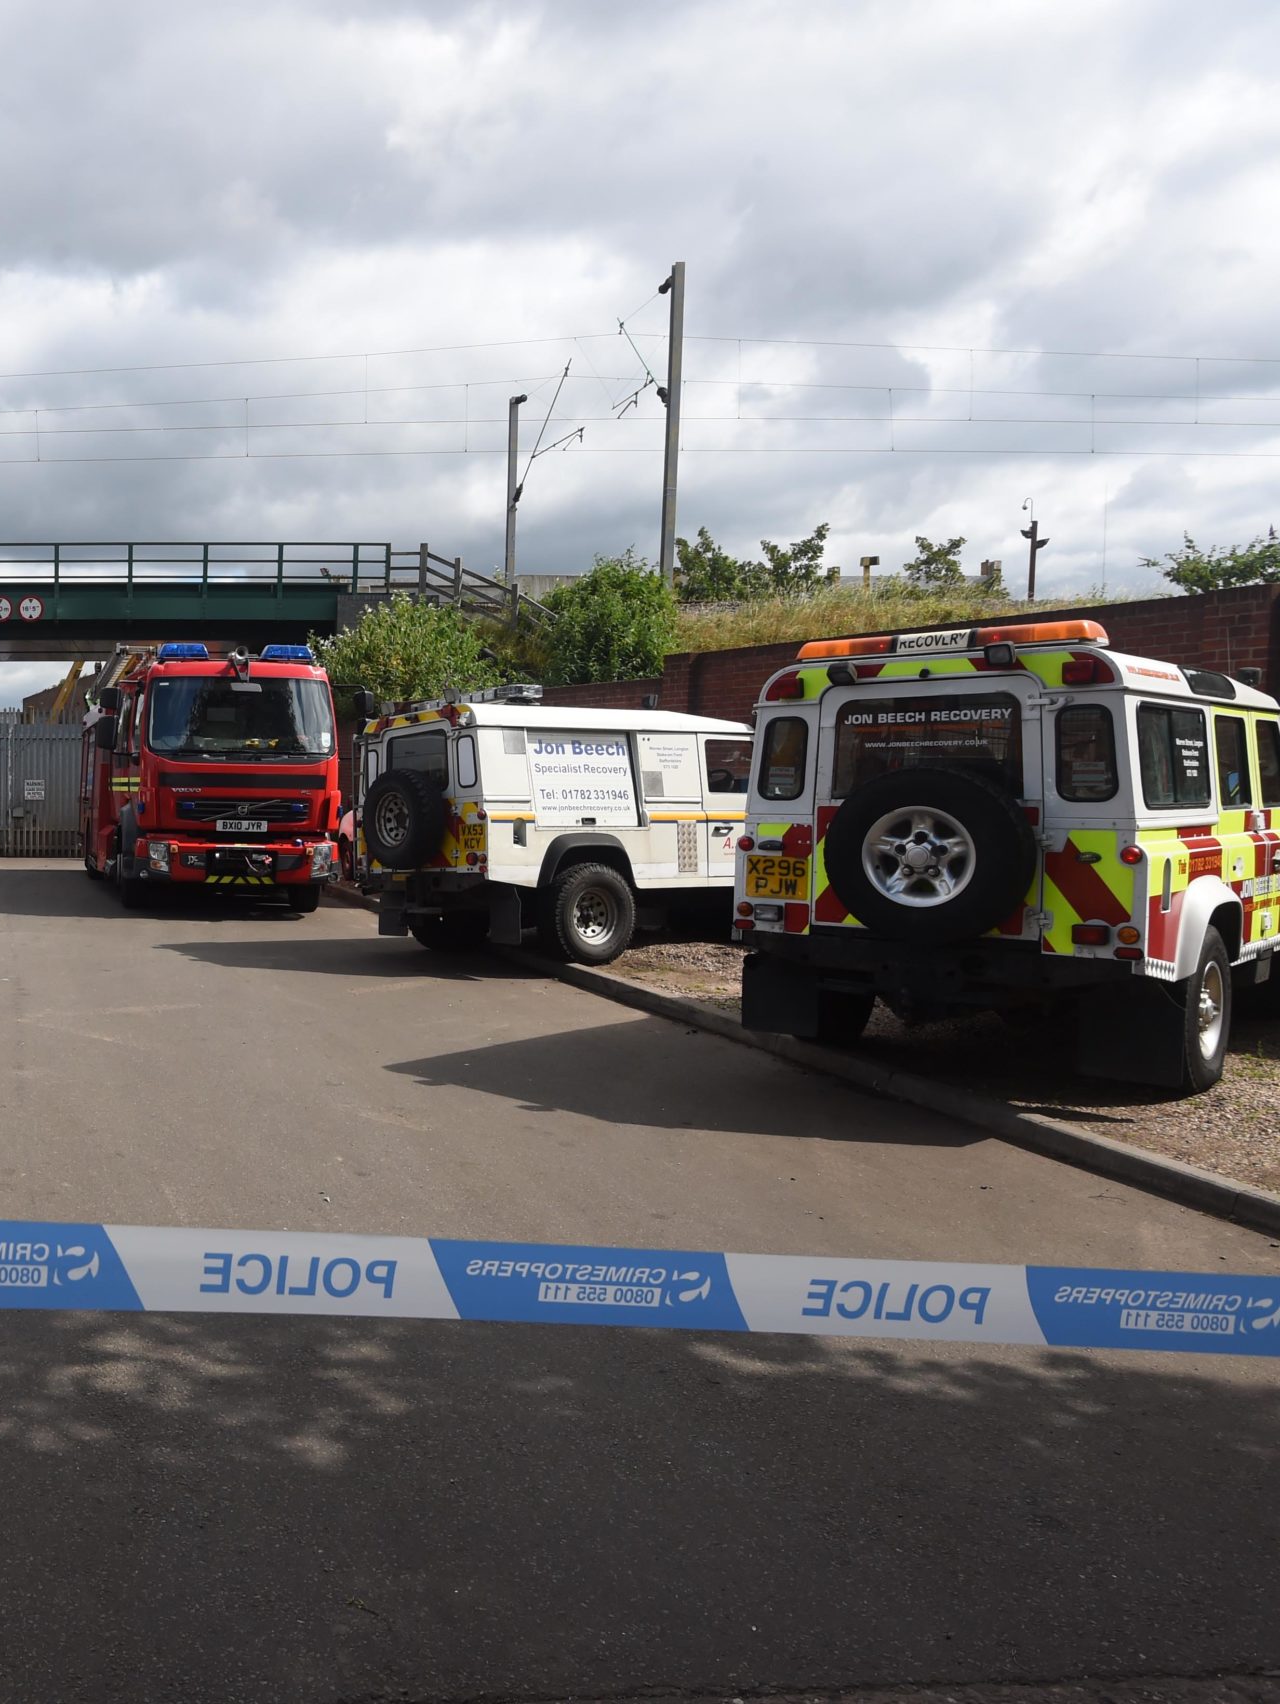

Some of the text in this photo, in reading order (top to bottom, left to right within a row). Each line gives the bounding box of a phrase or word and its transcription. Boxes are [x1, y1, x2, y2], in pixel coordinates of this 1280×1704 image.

[844, 708, 1012, 725] JON BEECH RECOVERY
[533, 739, 626, 756] Jon Beech
[534, 763, 628, 777] Specialist Recovery
[540, 789, 629, 800] Tel: 01782 331946
[542, 805, 630, 813] www.jonbeechrecovery.co.uk
[222, 821, 262, 831] BX10 JYR
[461, 825, 484, 837] VX53
[464, 837, 481, 849] KCY
[748, 858, 806, 877] X296
[754, 877, 798, 896] PJW
[1240, 879, 1254, 899] JON
